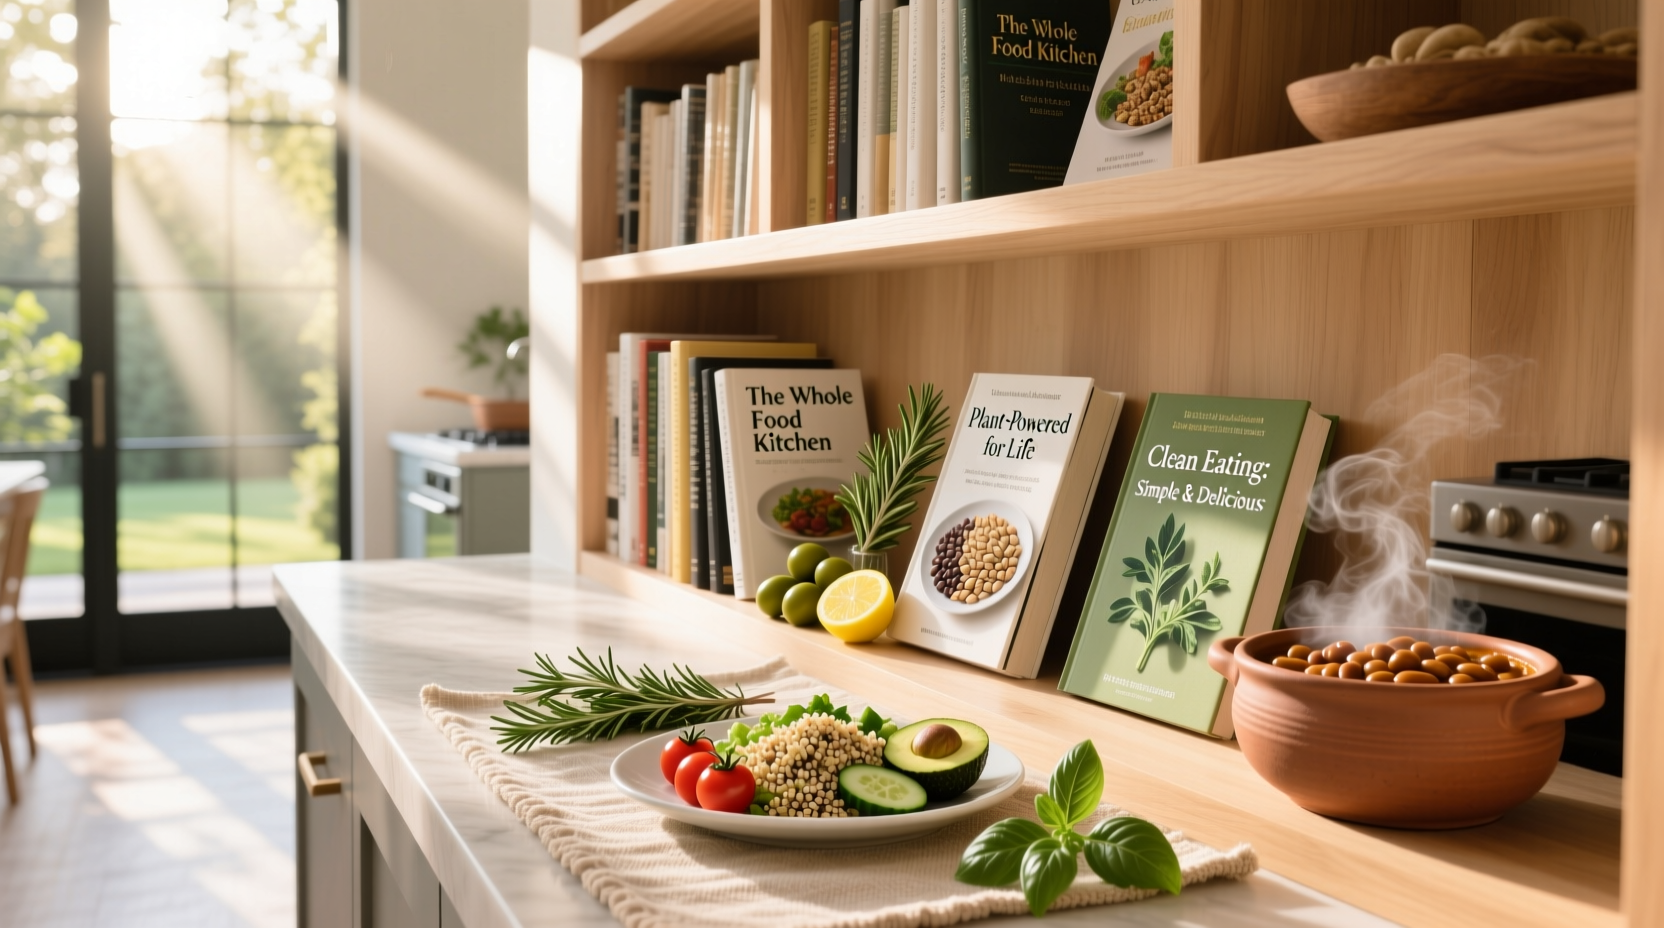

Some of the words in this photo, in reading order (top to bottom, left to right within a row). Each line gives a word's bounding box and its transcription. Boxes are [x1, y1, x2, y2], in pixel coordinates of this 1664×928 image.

[997, 14, 1028, 34] The
[991, 36, 1032, 58] Food
[1037, 41, 1098, 65] Kitchen
[745, 385, 785, 406] The
[789, 385, 853, 405] Whole
[751, 409, 802, 429] Food
[968, 406, 1072, 434] Plant-Powered
[753, 432, 832, 452] Kitchen
[983, 435, 1006, 457] for
[1006, 437, 1036, 460] Life
[1147, 444, 1198, 471] Clean
[1201, 449, 1270, 486] Eating:
[1134, 479, 1180, 504] Simple
[1182, 483, 1194, 503] &
[1196, 486, 1266, 512] Delicious
